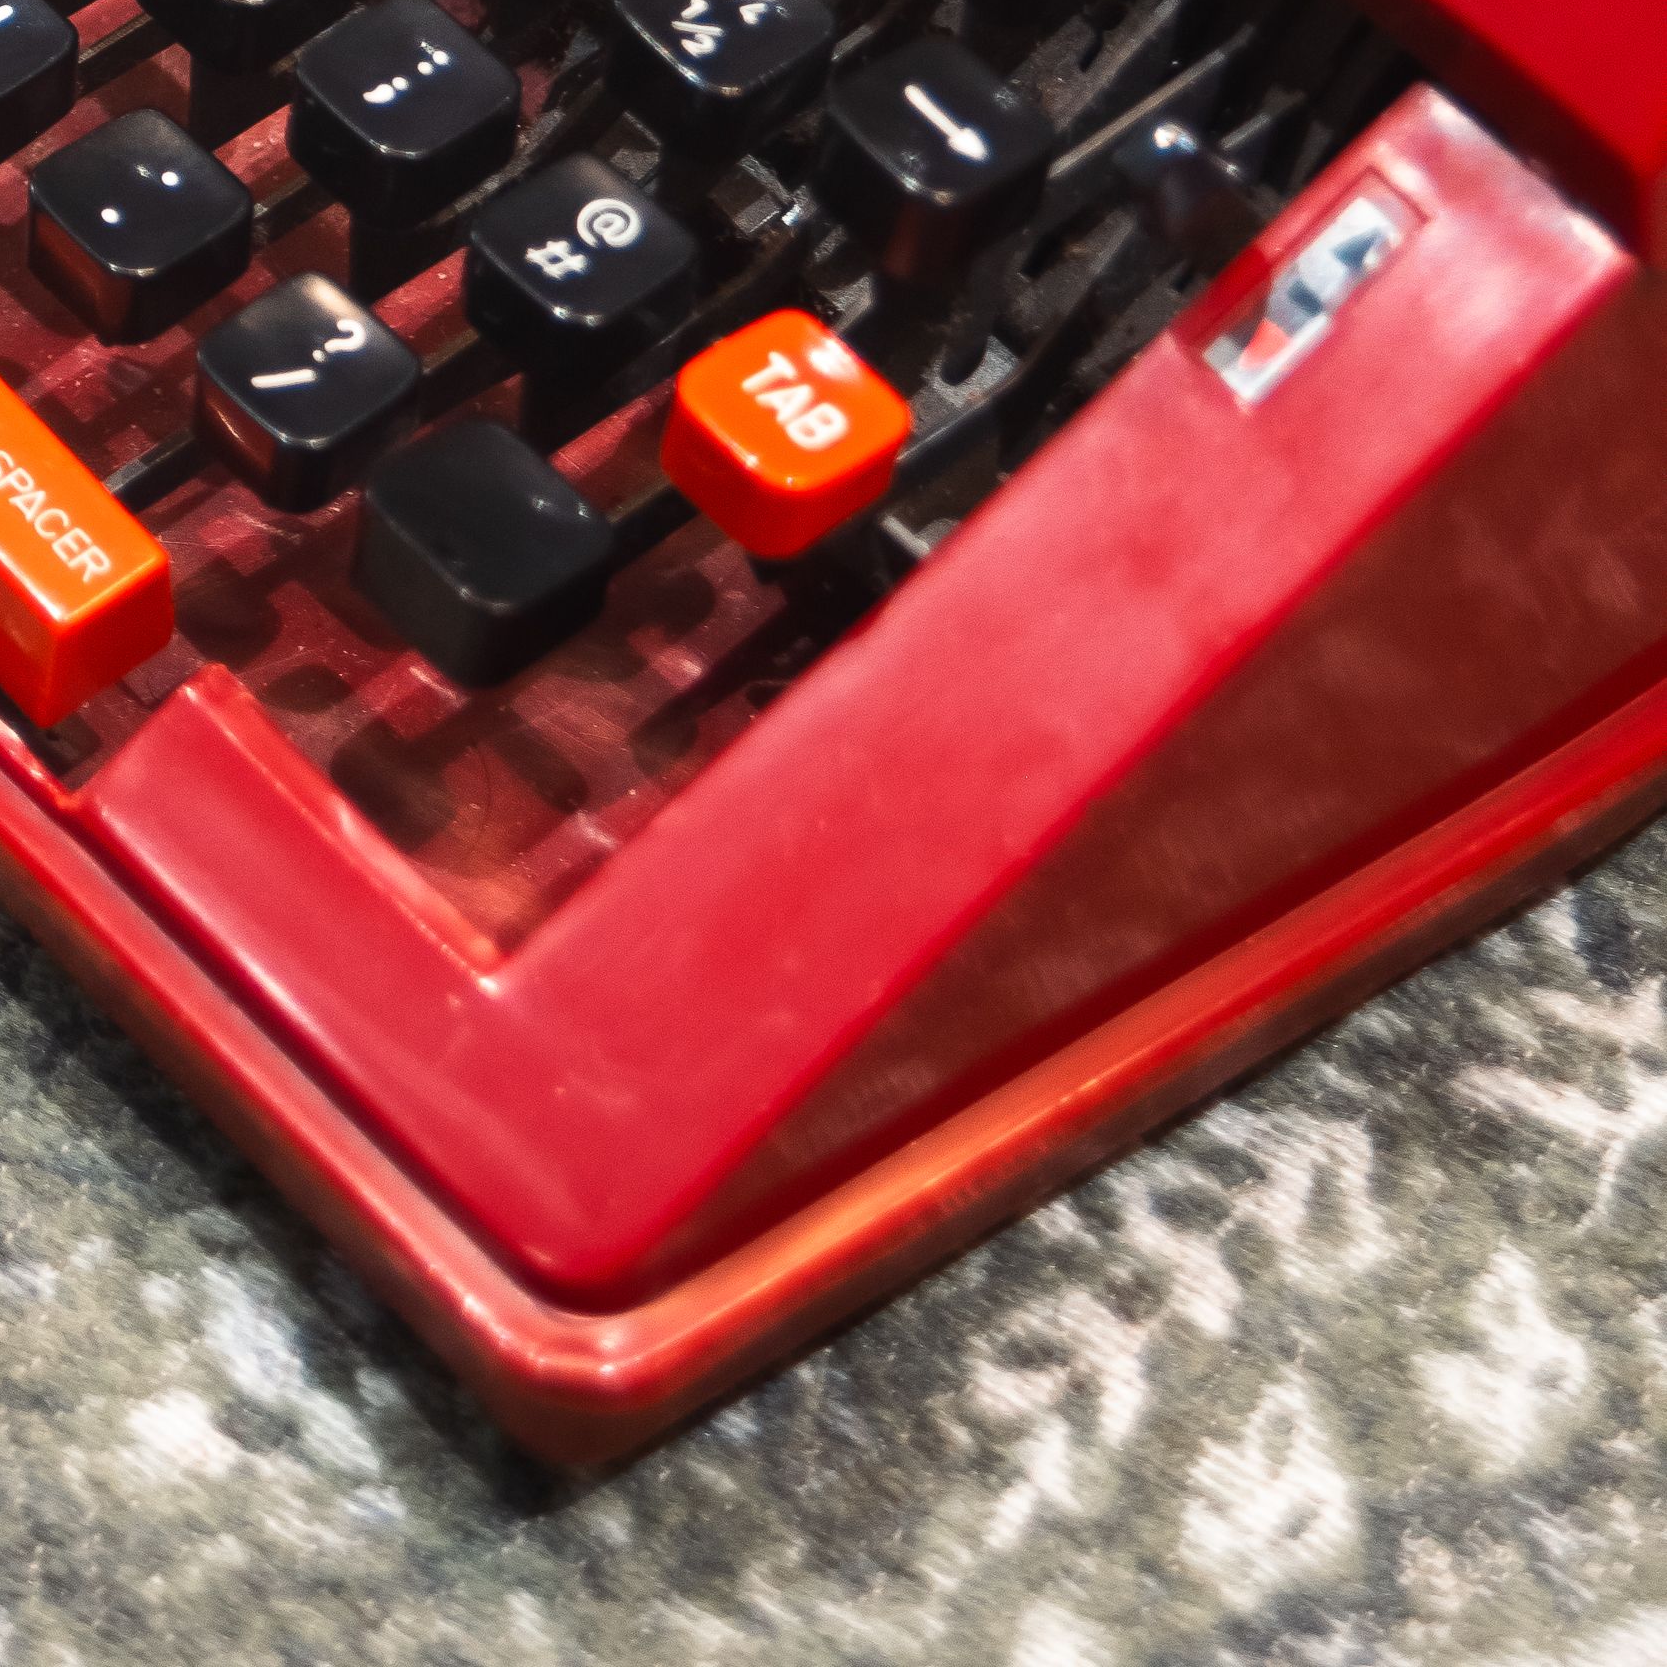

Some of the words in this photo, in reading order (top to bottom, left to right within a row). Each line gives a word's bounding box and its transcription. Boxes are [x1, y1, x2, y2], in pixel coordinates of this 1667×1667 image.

[576, 196, 642, 248] @
[525, 239, 589, 279] #
[312, 318, 367, 363] ?
[741, 350, 850, 452] TAB
